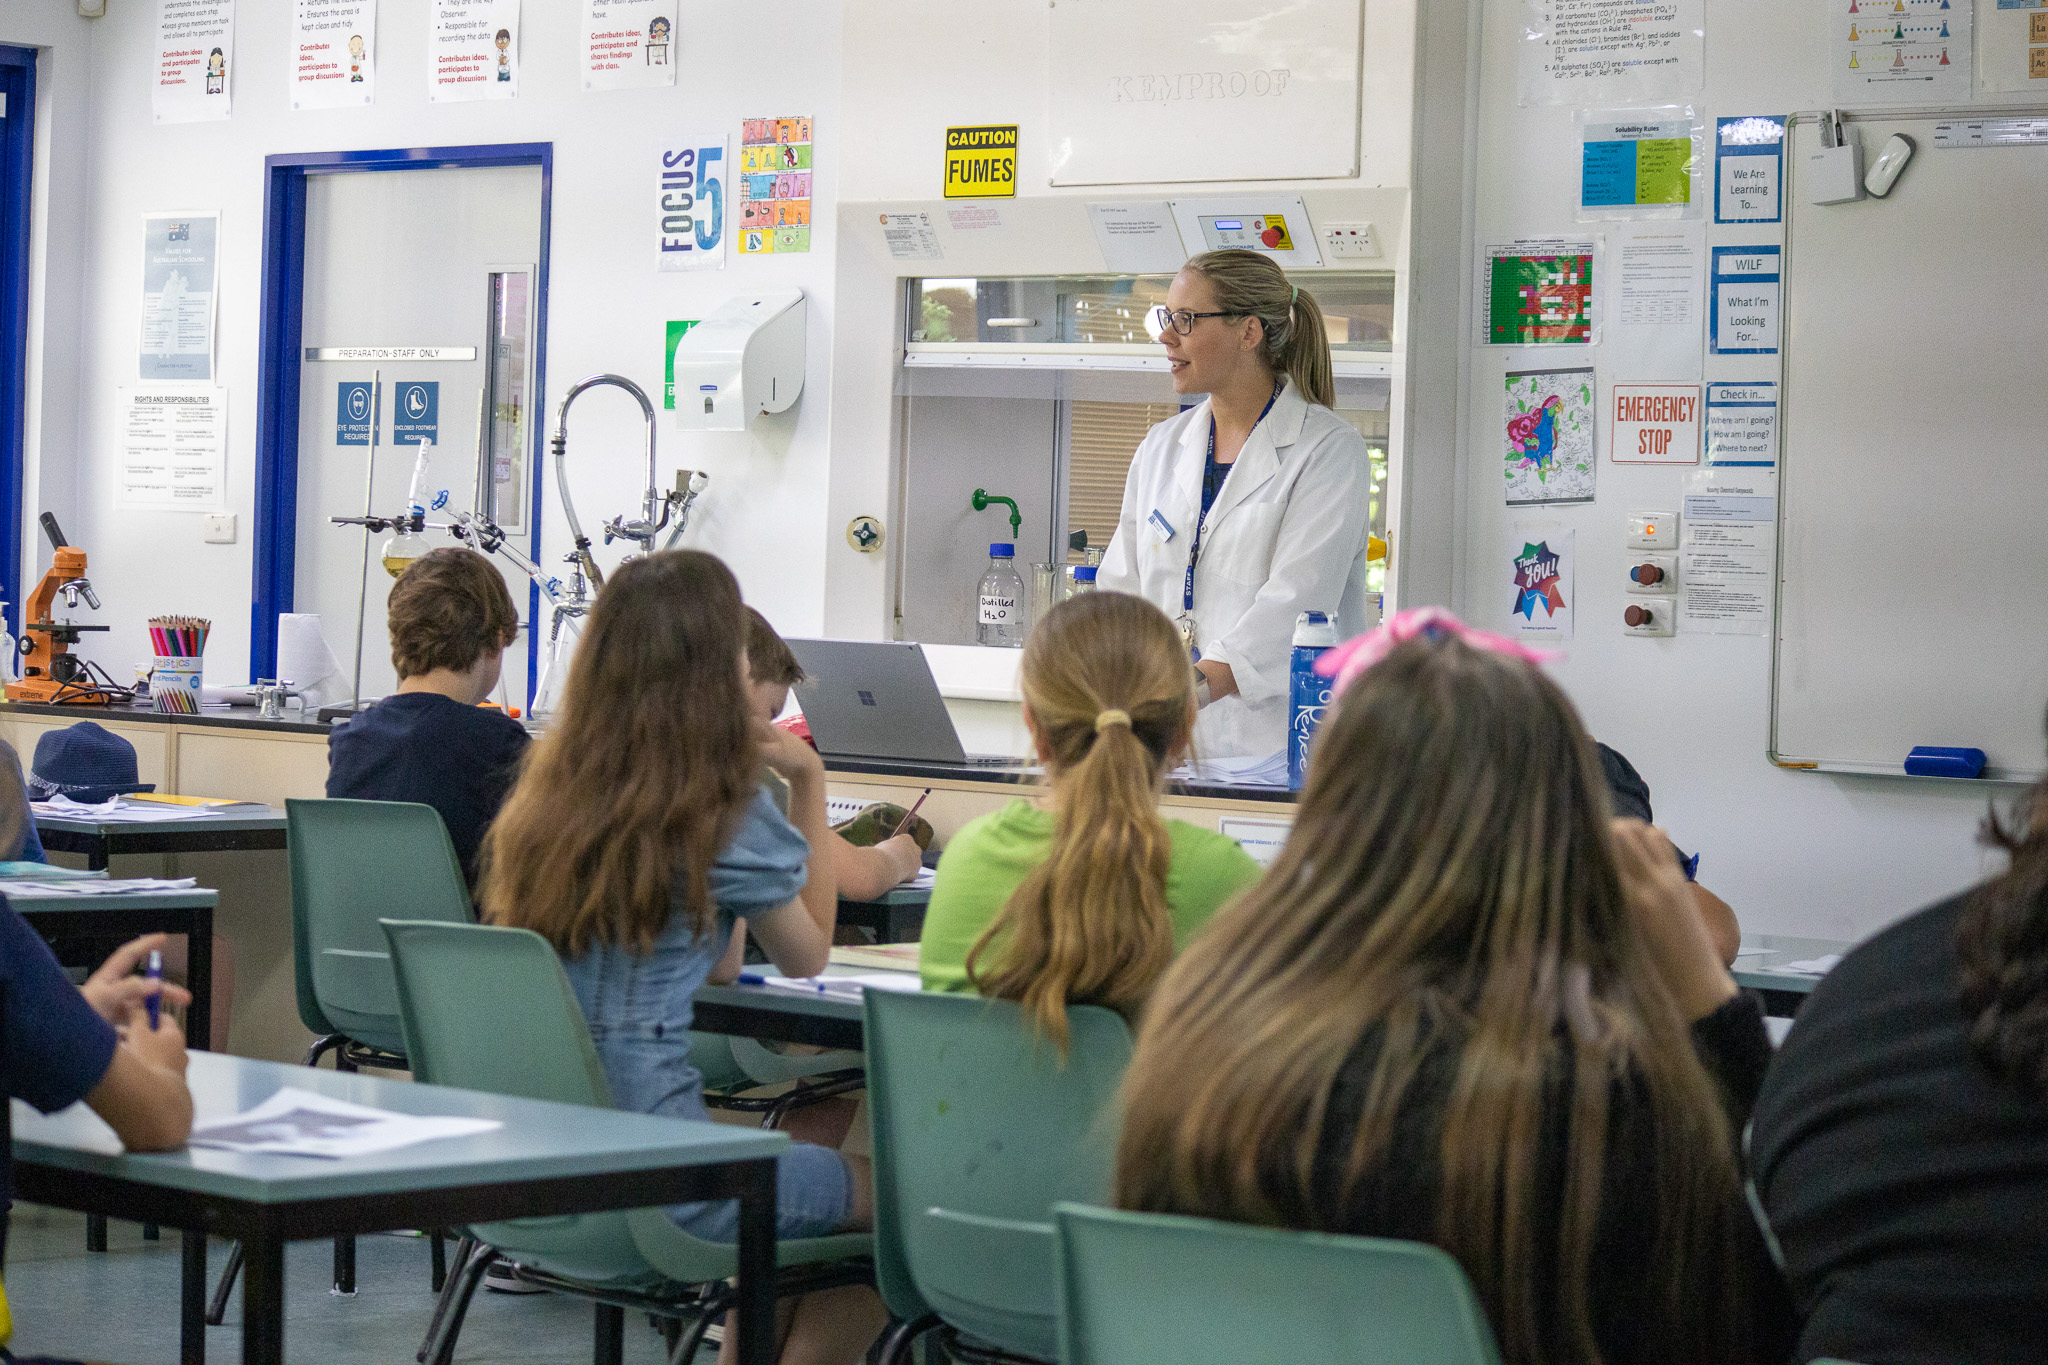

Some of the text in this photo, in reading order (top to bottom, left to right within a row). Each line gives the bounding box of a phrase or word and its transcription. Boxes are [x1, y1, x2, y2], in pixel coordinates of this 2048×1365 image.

[593, 11, 607, 19] have.
[1565, 12, 1596, 20] carbonates
[1621, 7, 1653, 16] phosphates
[302, 23, 313, 32] kept
[315, 22, 329, 30] clean
[342, 19, 353, 28] tidy
[445, 20, 488, 30] Responsible for
[1567, 19, 1598, 28] hydroxides
[2037, 24, 2046, 33] La
[199, 29, 223, 37] participate
[439, 35, 465, 43] recording
[478, 32, 490, 40] data
[591, 29, 642, 40] Contributes ideas,
[591, 40, 637, 51] participates and
[1600, 44, 1620, 52] except
[163, 50, 189, 58] Contributes
[439, 53, 489, 63] Contributes ideas,
[591, 51, 633, 61] shares findings
[172, 59, 200, 67] participates
[299, 63, 330, 72] participates
[1561, 63, 1589, 71] sulphates
[1622, 59, 1642, 67] soluble
[1643, 58, 1664, 66] except
[1665, 56, 1679, 64] with
[2036, 59, 2046, 68] Ac
[439, 66, 472, 74] participates
[299, 72, 344, 82] group discussions
[439, 77, 455, 85] group
[1110, 69, 1290, 103] KEMPROOF
[948, 130, 1016, 147] CAUTION
[948, 157, 1013, 184] FUMES
[1733, 170, 1766, 179] We Are
[1730, 185, 1769, 196] Learning
[661, 147, 723, 252] FOCUS 5
[1740, 199, 1758, 209] To...
[1735, 259, 1763, 271] WILF
[1727, 297, 1753, 307] What
[1730, 316, 1766, 328] Looking
[1736, 331, 1759, 341] For...
[338, 349, 440, 358] PREPARATION-STAFF ONLY
[1720, 389, 1766, 399] Check in...
[1617, 396, 1697, 423] EMERGENCY
[1710, 416, 1733, 424] Where
[1750, 416, 1774, 426] going?
[337, 424, 379, 432] EYE PROTECTN
[1713, 430, 1730, 438] How
[1746, 430, 1770, 440] going?
[1638, 428, 1672, 455] STOP
[1716, 444, 1739, 452] Where
[1748, 444, 1768, 452] next?
[1518, 553, 1539, 569] Thank
[981, 597, 1014, 608] Distilled
[20, 691, 43, 699] extreme
